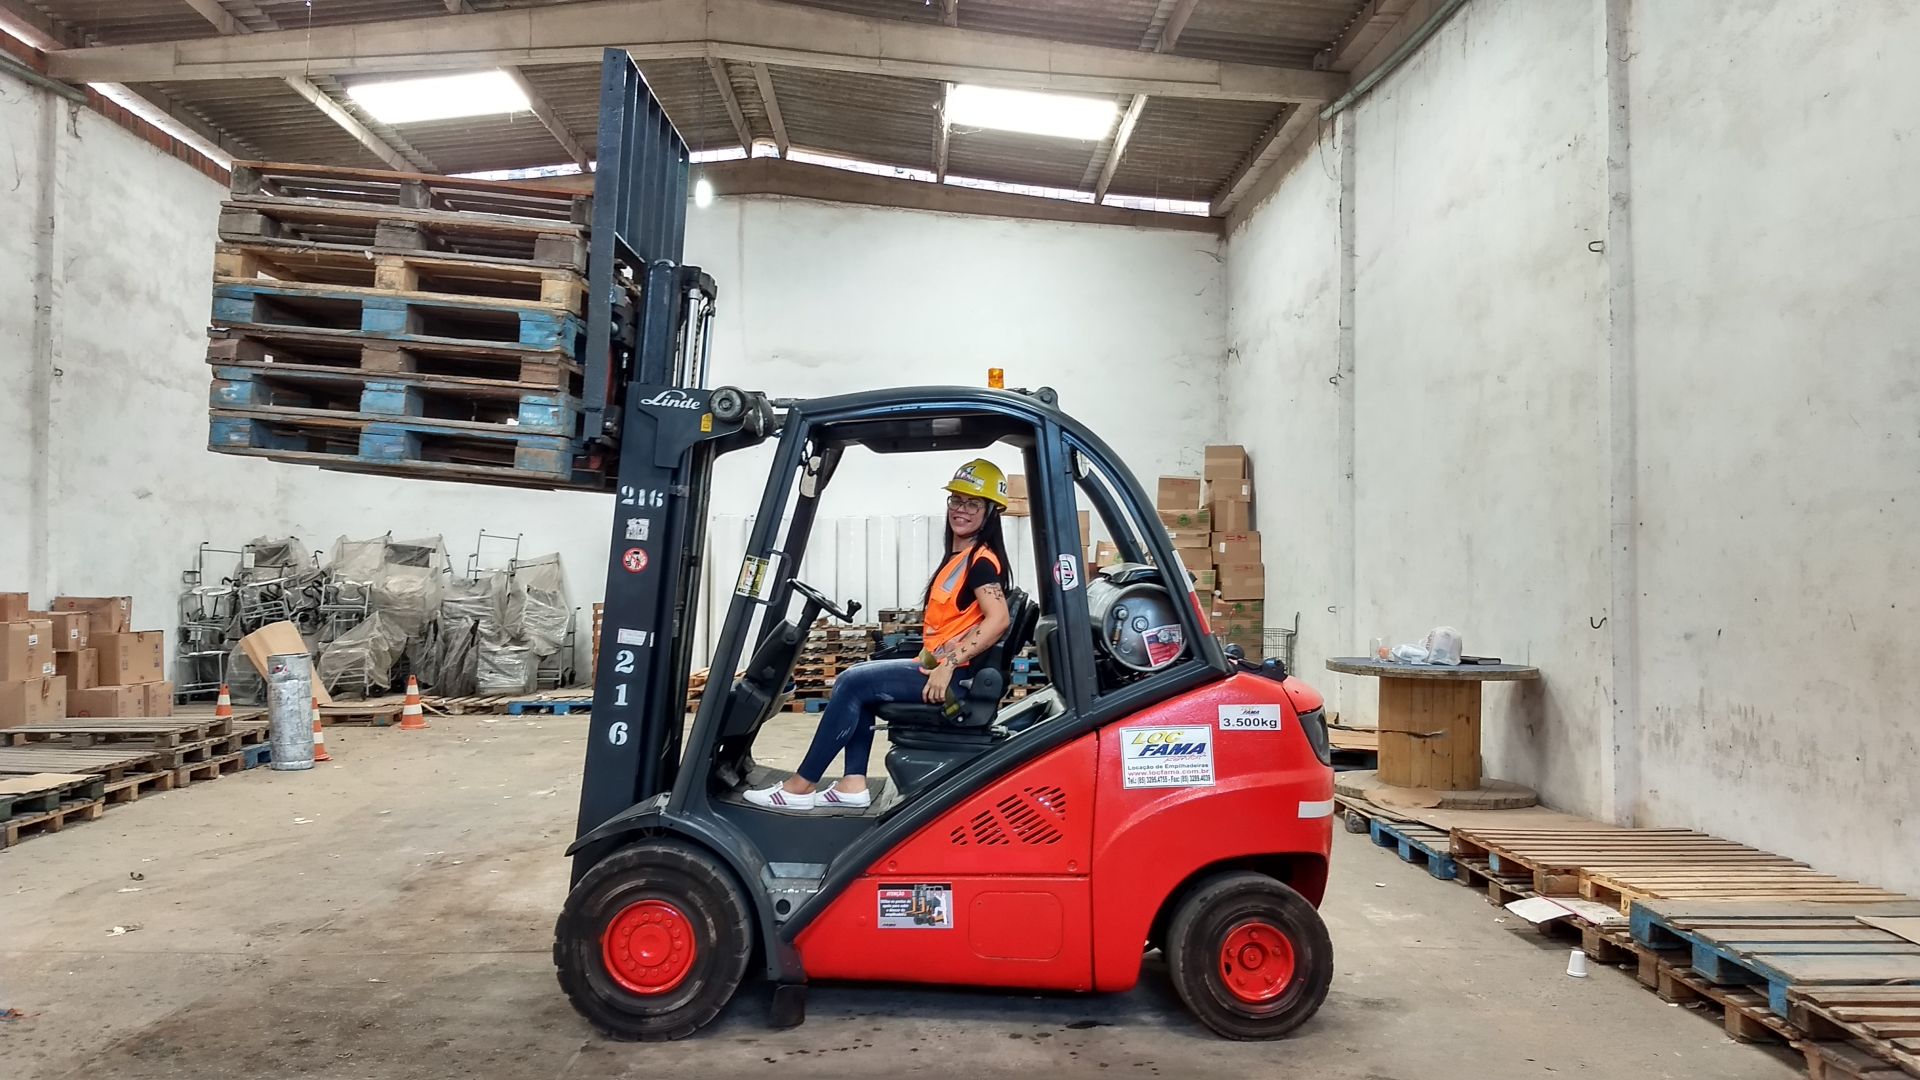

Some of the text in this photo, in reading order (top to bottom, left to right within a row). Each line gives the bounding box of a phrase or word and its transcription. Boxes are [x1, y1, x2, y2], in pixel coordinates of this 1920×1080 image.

[641, 390, 700, 409] Linde
[621, 485, 664, 508] 216
[1223, 717, 1278, 729] 3.500kg
[1131, 731, 1184, 745] LOC
[1138, 743, 1207, 757] FAMA
